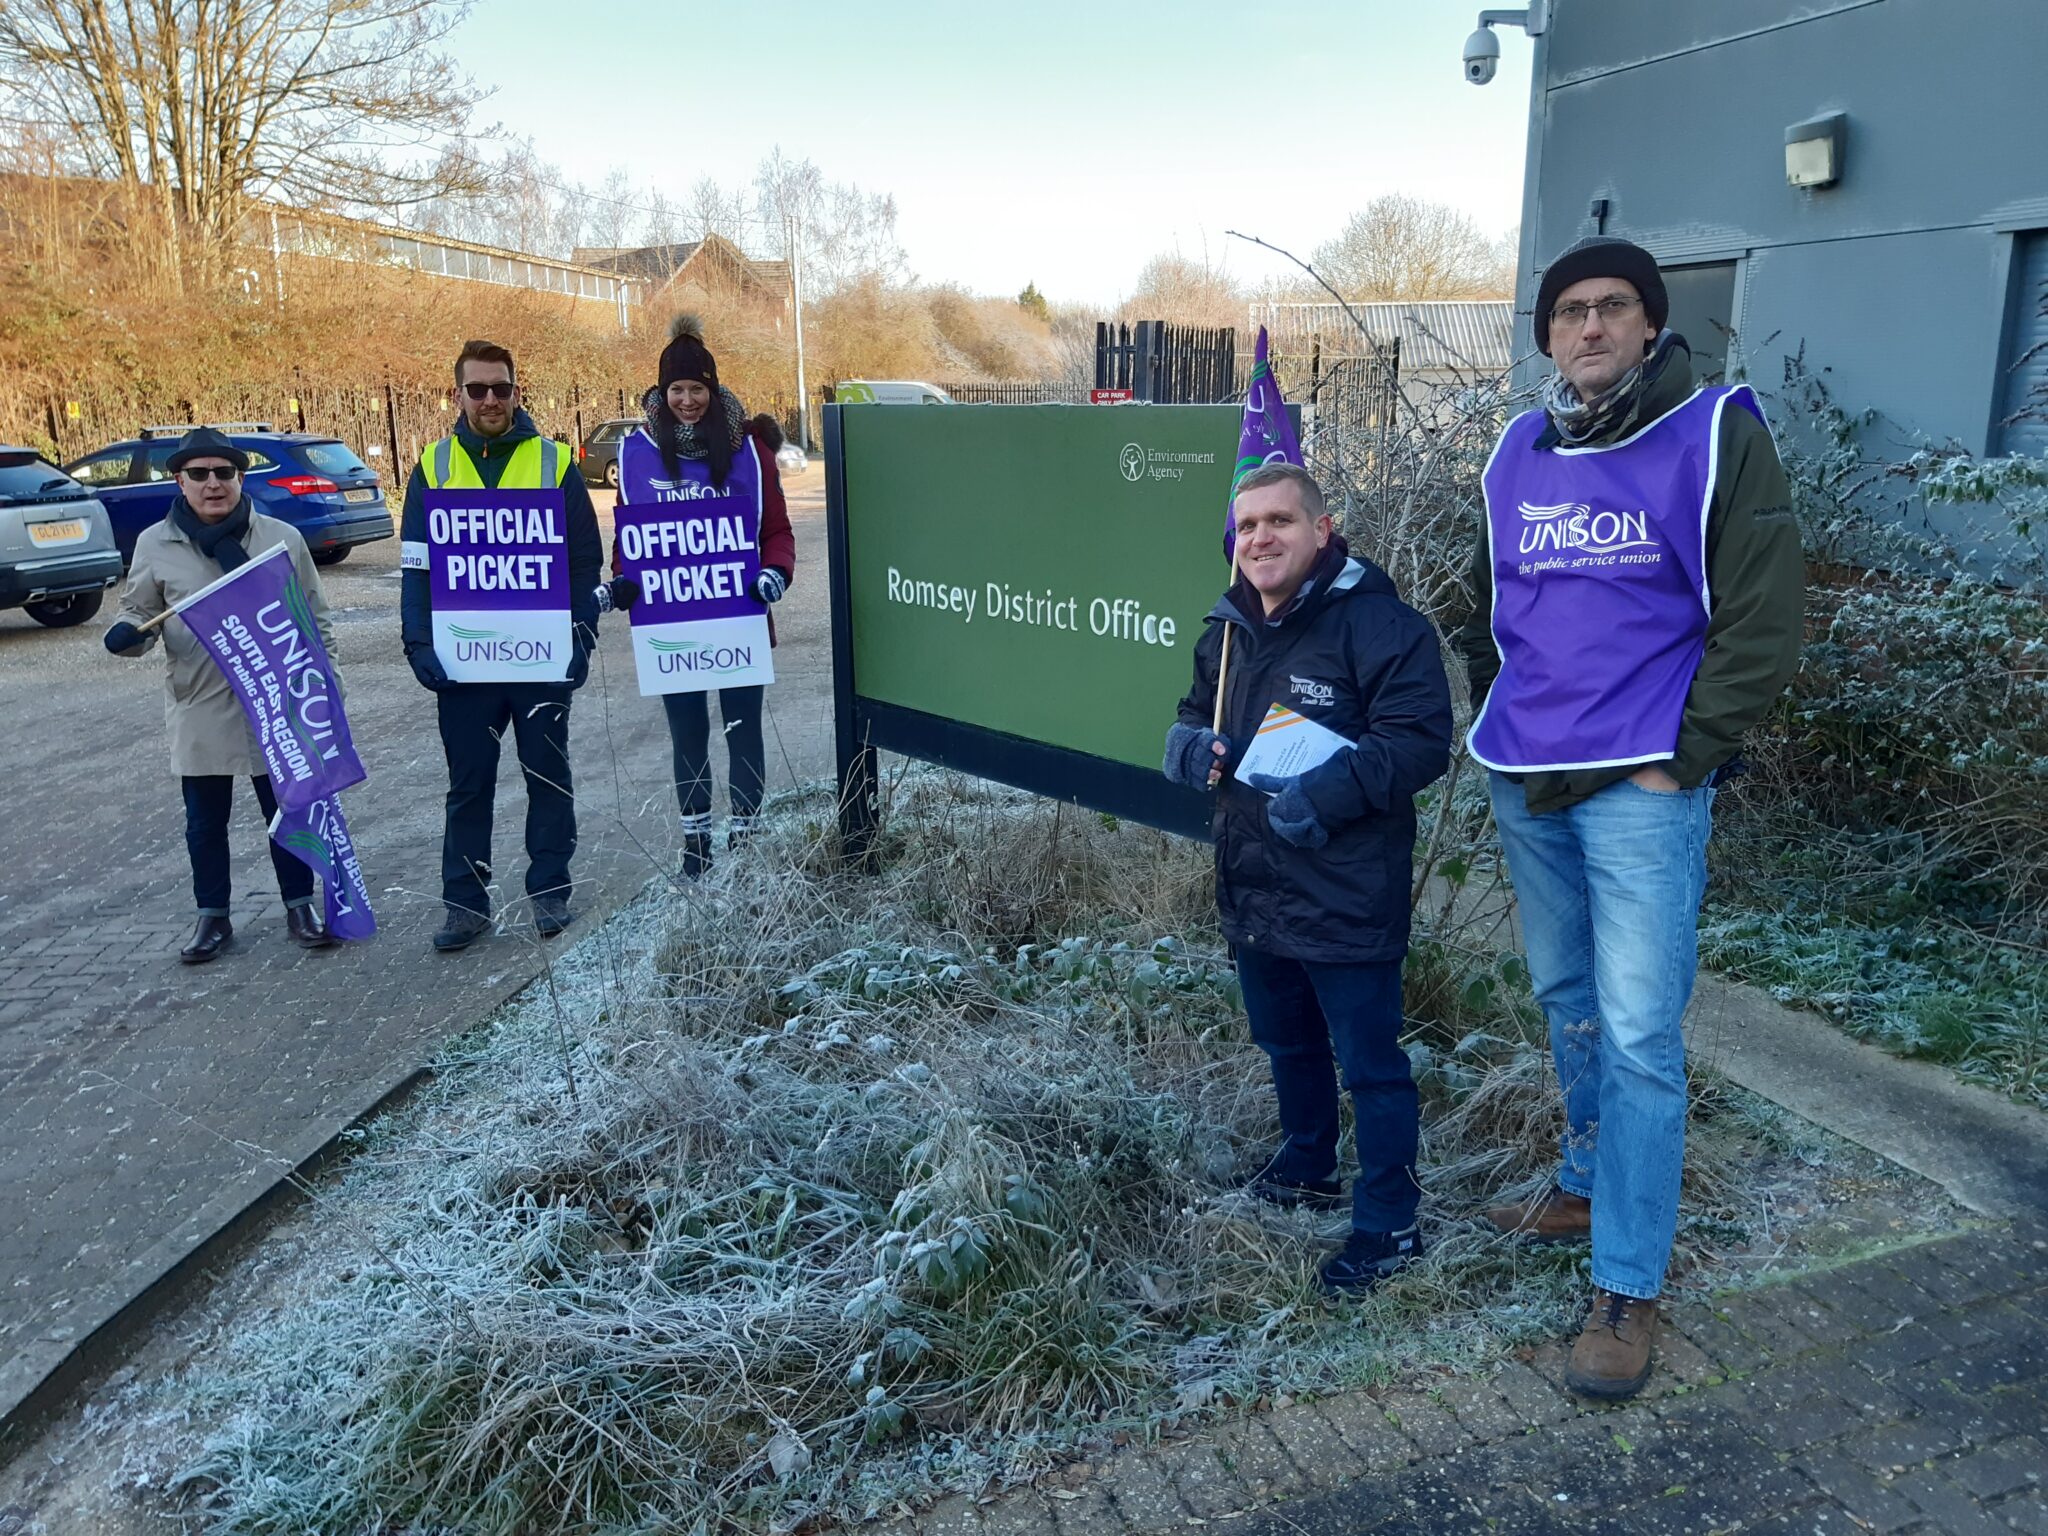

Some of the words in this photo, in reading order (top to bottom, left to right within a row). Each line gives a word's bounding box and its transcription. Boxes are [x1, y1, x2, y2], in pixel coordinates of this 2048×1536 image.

[1147, 448, 1215, 464] Environment
[1147, 464, 1184, 482] Agency
[429, 508, 564, 545] OFFICIAL
[621, 515, 755, 561] OFFICIAL
[1519, 510, 1648, 554] UNISON
[447, 554, 553, 591] PICKET
[1518, 561, 1531, 575] the
[1533, 556, 1568, 575] public
[1571, 553, 1616, 568] service
[1619, 550, 1662, 564] union
[641, 561, 746, 605] PICKET
[887, 565, 977, 624] Romsey
[986, 582, 1079, 632] District
[1089, 597, 1177, 647] Office
[456, 640, 552, 662] UNISON
[657, 646, 752, 675] UNISON
[210, 629, 232, 657] The
[228, 655, 258, 698] Public
[252, 697, 269, 745] Service
[263, 744, 285, 785] Union
[221, 614, 269, 672] SOUTH
[259, 671, 282, 716] EAST
[272, 715, 314, 782] REGION
[1290, 683, 1332, 697] UNISON
